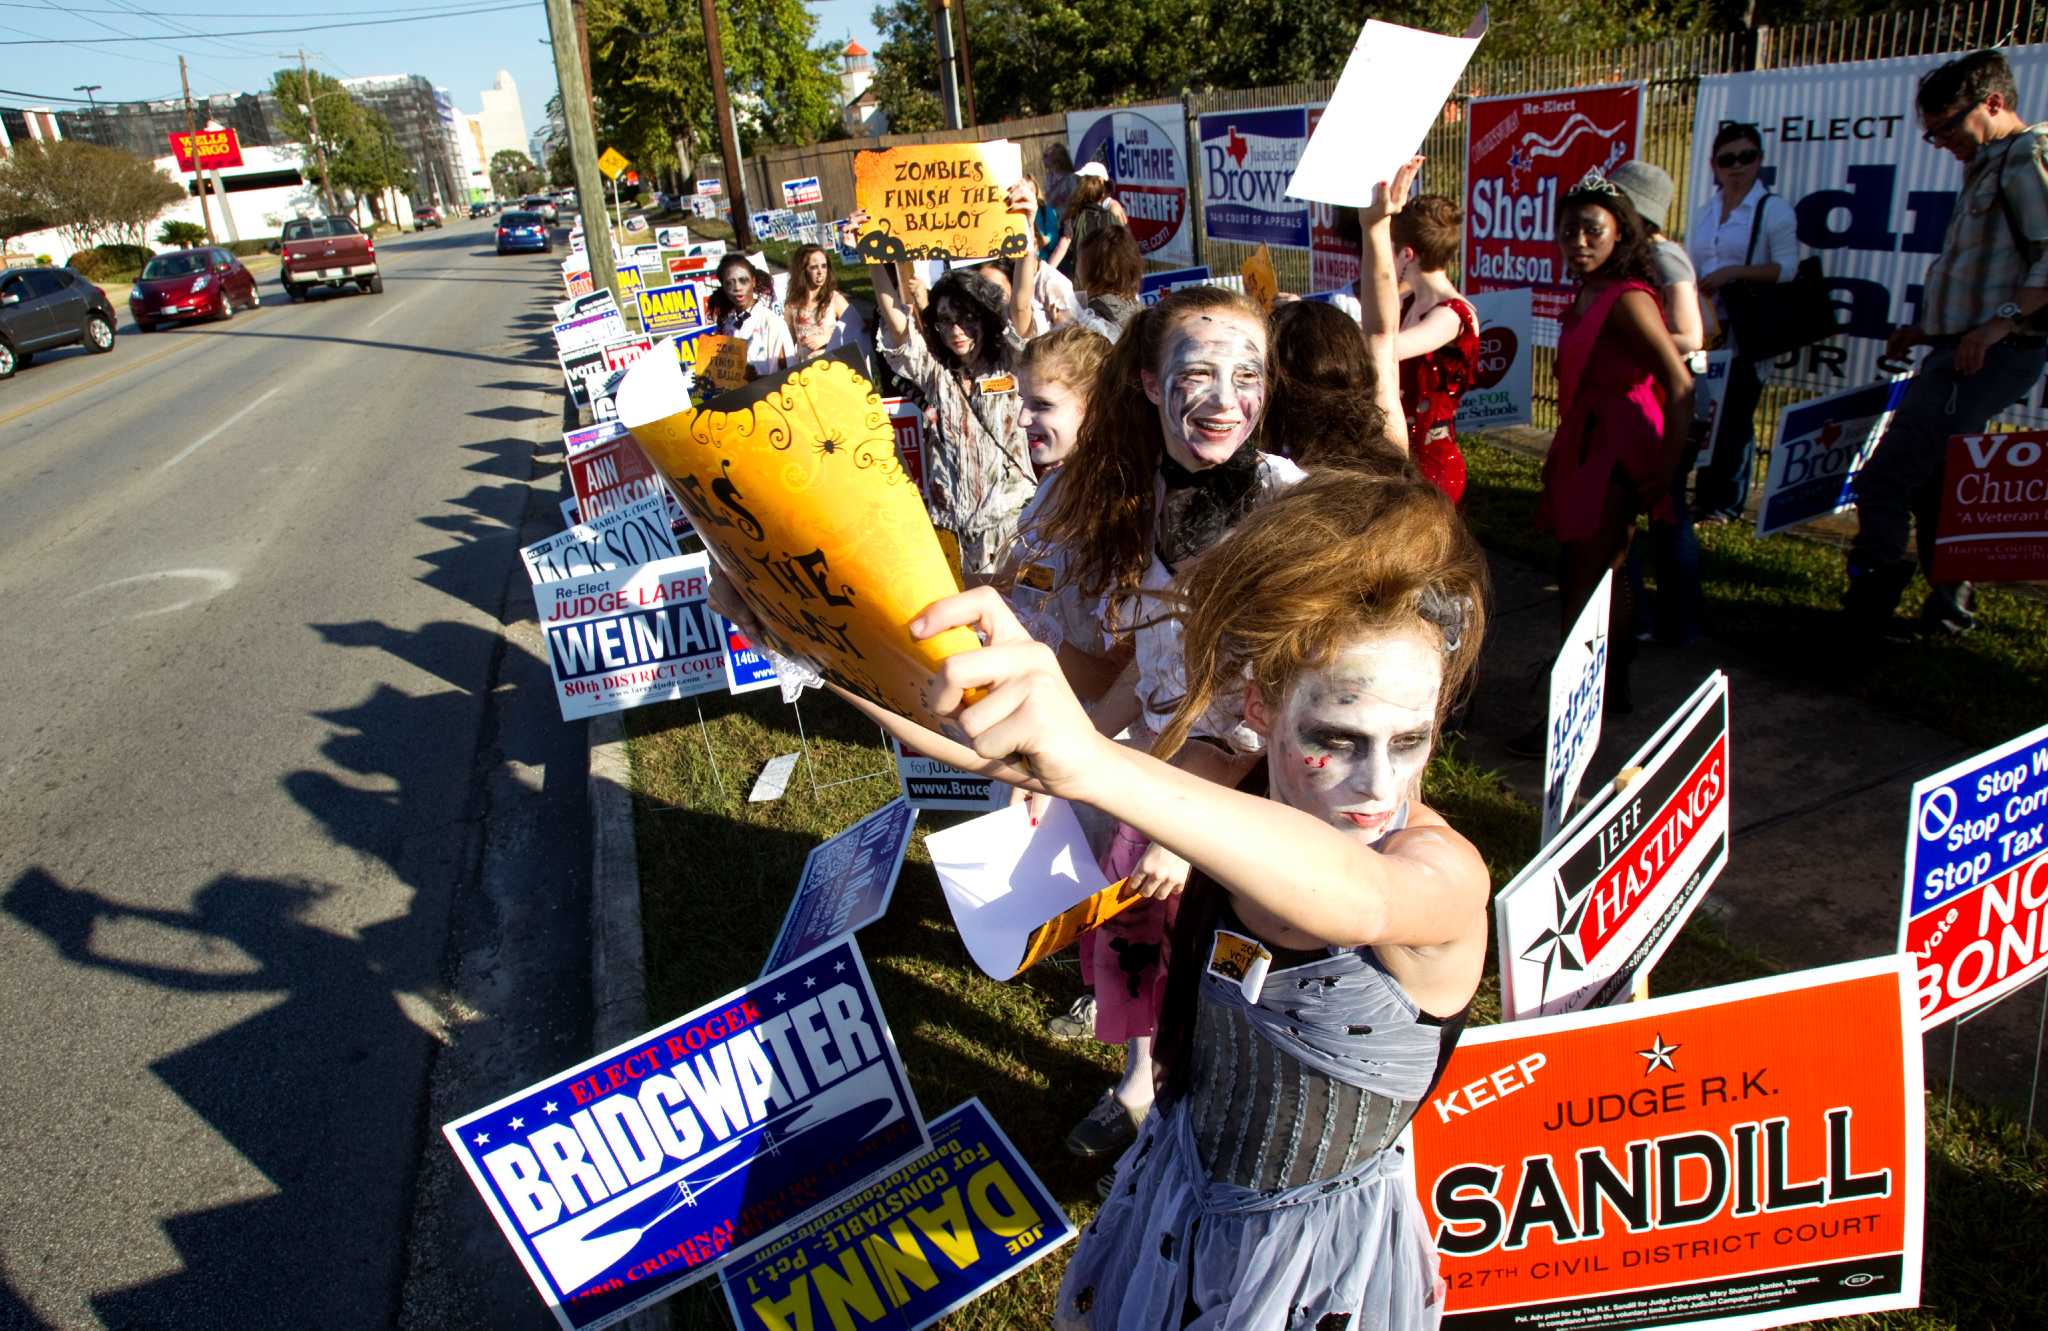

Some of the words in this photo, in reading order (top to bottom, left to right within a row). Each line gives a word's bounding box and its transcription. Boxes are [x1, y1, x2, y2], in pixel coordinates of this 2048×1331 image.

[1522, 99, 1576, 115] Re-Elect
[894, 160, 984, 182] ZOMBIES
[1117, 143, 1175, 180] GUTHRIE
[884, 186, 951, 210] FINISH
[960, 185, 999, 205] THE
[1119, 190, 1180, 223] SHERIFF
[1471, 176, 1558, 241] Sheil
[905, 210, 988, 232] BALLOT
[1225, 214, 1250, 224] COURT
[1253, 215, 1262, 225] OF
[1264, 216, 1303, 228] APPEALS
[1470, 246, 1552, 284] Jackson
[639, 288, 697, 318] DANNA
[568, 363, 606, 381] VOTE
[1469, 403, 1519, 419] Schools
[586, 453, 620, 493] ANN
[1956, 472, 2048, 505] Chuc
[583, 474, 660, 523] JOHNSON
[1977, 511, 2039, 524] Veteran
[533, 509, 676, 583] JACKSON
[547, 591, 629, 623] JUDGE
[639, 575, 710, 606] LARR
[555, 580, 611, 600] Re-Elect
[564, 676, 600, 698] 80th
[602, 663, 677, 691] DISTRICT
[681, 654, 726, 675] COUR
[734, 650, 760, 667] 14th
[911, 761, 927, 774] for
[1976, 763, 2028, 803] Stop
[1593, 758, 1720, 941] HASTINGS
[1597, 797, 1642, 870] JEFF
[1946, 811, 2000, 852] Stop
[1923, 851, 1992, 900] Stop
[1998, 822, 2045, 863] Tax
[570, 1044, 666, 1106] ELECT
[666, 1000, 763, 1061] ROGER
[1432, 1051, 1548, 1124] KEEP
[1543, 1082, 1686, 1132] JUDGE
[1701, 1067, 1779, 1108] R.K.
[482, 981, 881, 1236] BRIDGWATER
[953, 1143, 992, 1172] For
[1432, 1105, 1892, 1257] SANDILL
[626, 1216, 738, 1282] CRIMINAL
[1004, 1223, 1046, 1256] JOE
[1530, 1254, 1610, 1280] CIVIL
[1622, 1231, 1762, 1267] DISTRICT
[1773, 1213, 1882, 1245] COURT
[1583, 1307, 1596, 1315] The
[1710, 1289, 1727, 1300] Mary
